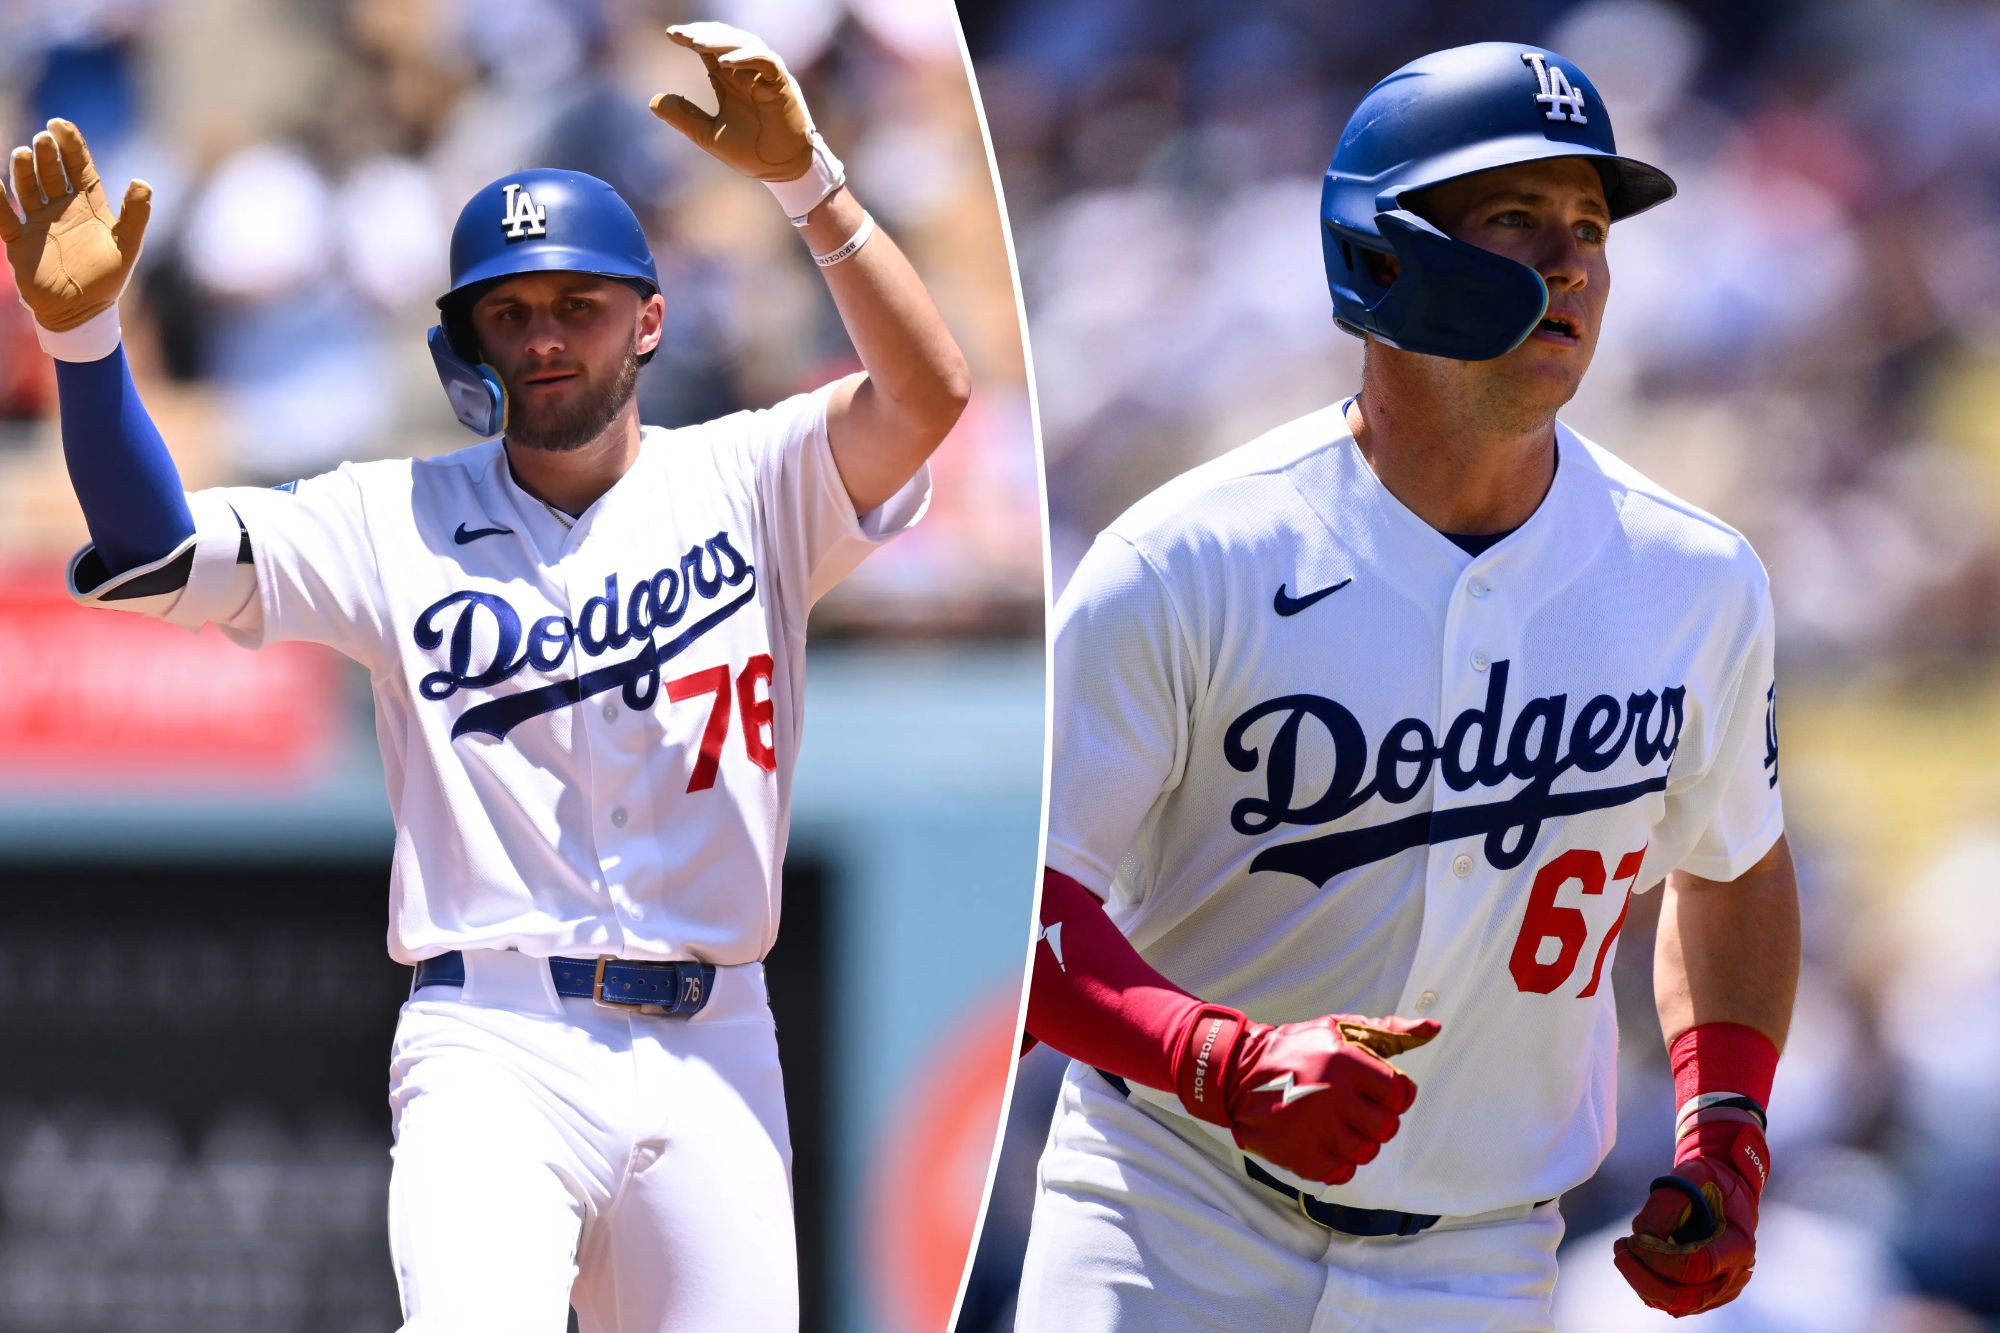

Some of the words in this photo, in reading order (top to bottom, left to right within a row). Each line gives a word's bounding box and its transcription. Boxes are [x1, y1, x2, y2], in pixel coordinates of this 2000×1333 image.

[1522, 53, 1588, 124] LA
[501, 184, 546, 238] LA
[828, 242, 857, 263] BRUCE
[413, 531, 756, 711] Dodgers
[665, 652, 778, 794] 76
[684, 977, 701, 1002] 76
[1200, 1019, 1223, 1060] BRUCE
[1195, 1067, 1206, 1102] BOLT
[1744, 1145, 1764, 1174] BOLT
